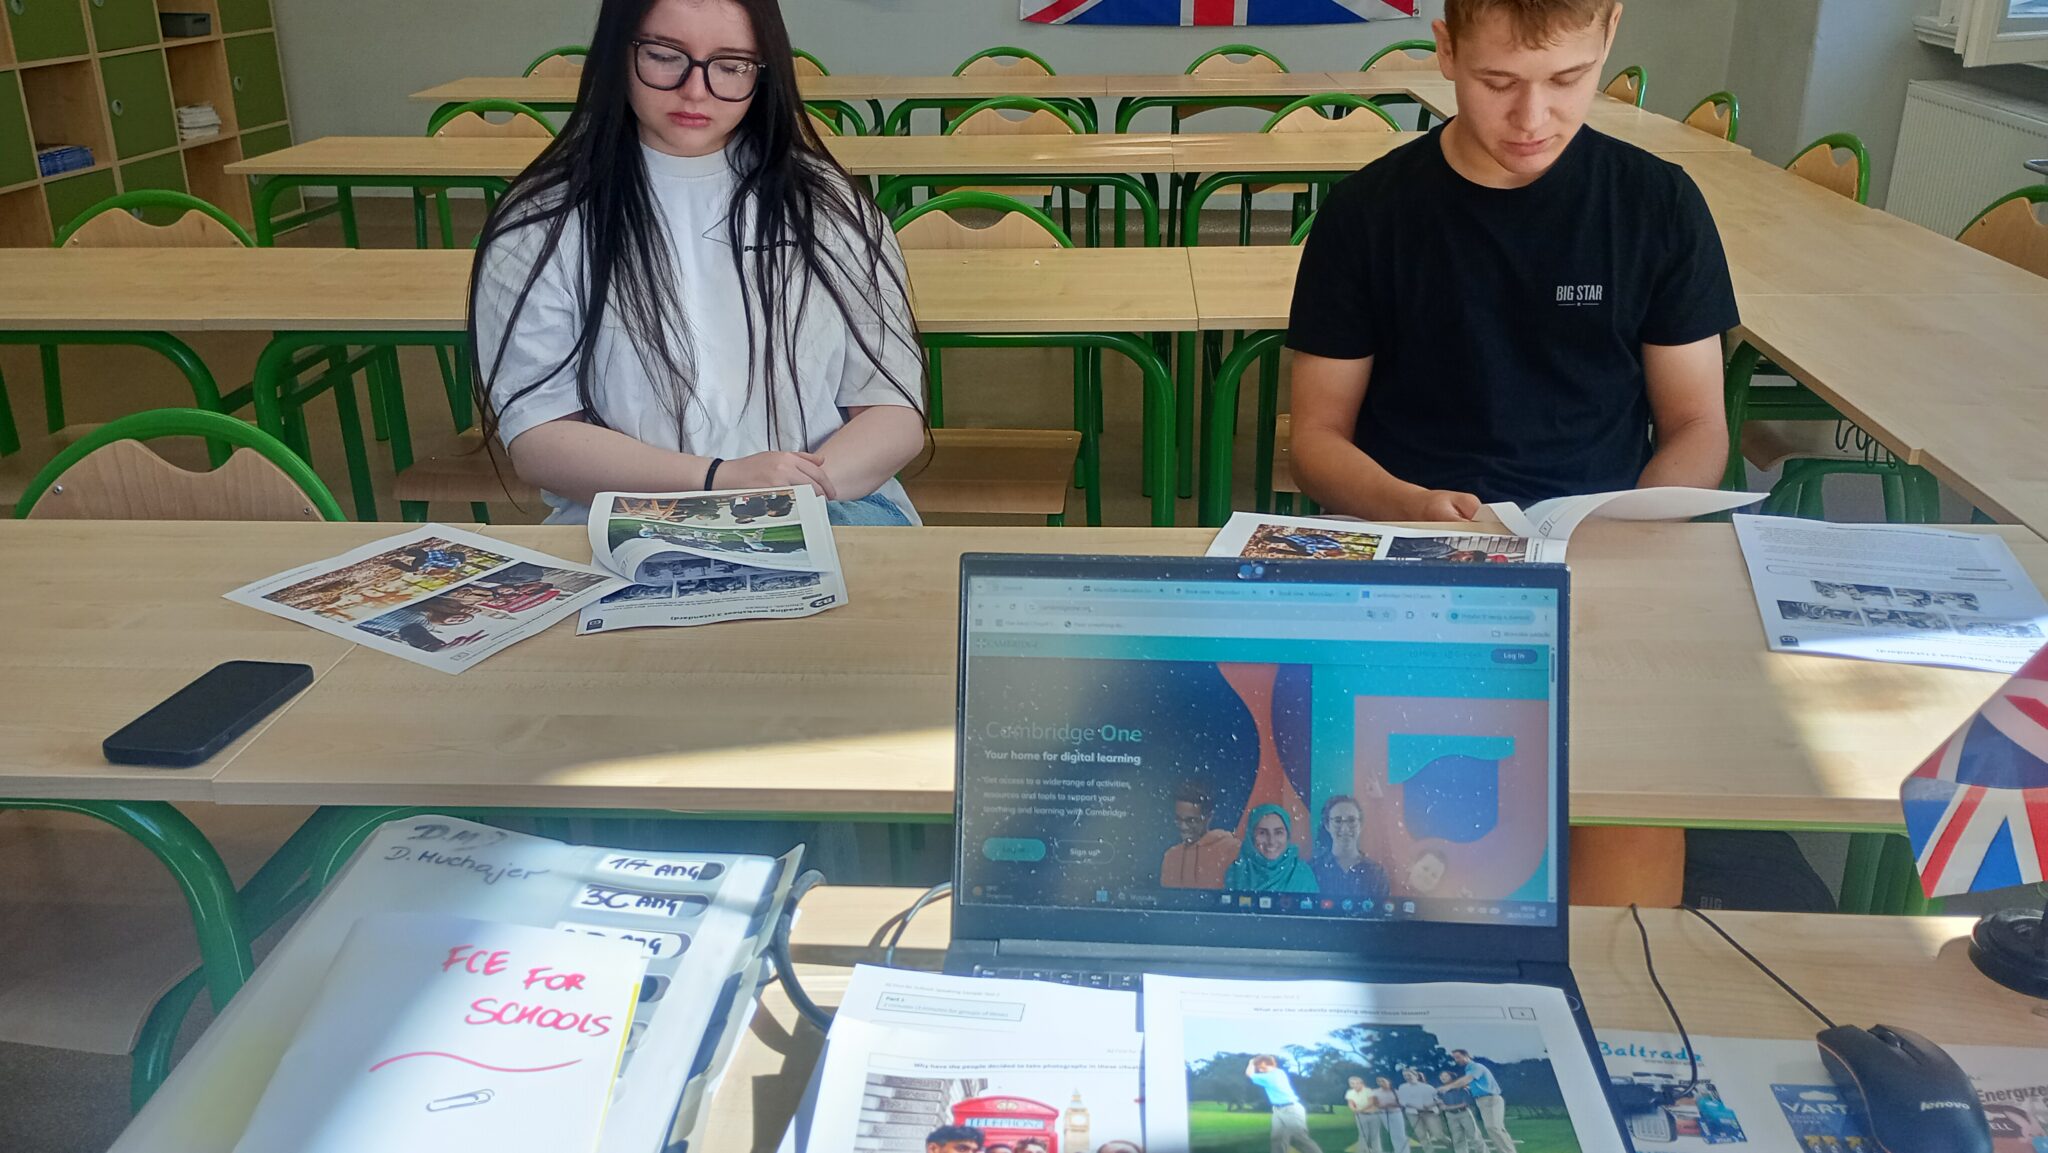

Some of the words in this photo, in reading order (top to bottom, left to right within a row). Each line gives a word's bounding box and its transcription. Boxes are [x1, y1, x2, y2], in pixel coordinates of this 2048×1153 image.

[1556, 285, 1574, 301] BIG
[1576, 285, 1603, 301] STAR
[1503, 652, 1516, 661] Log
[986, 721, 1095, 745] Cambridge
[1101, 724, 1143, 743] One
[984, 750, 1008, 760] Your
[1010, 750, 1040, 761] home
[1042, 751, 1058, 761] for
[1060, 751, 1094, 764] digital
[1097, 752, 1142, 766] learning
[1063, 780, 1086, 788] range
[1021, 792, 1036, 800] and
[1038, 792, 1056, 800] tools
[1068, 794, 1097, 802] support
[1017, 806, 1032, 814] and
[1034, 806, 1064, 816] learning
[1066, 808, 1083, 816] with
[1085, 808, 1127, 818] Cambridge
[1070, 847, 1086, 858] Sign
[443, 944, 511, 976] FCE
[523, 967, 587, 992] FOR
[464, 997, 611, 1037] SCHOOLS
[914, 1062, 928, 1070] Why
[1976, 1085, 2048, 1103] Energize
[1783, 1102, 1849, 1115] VART
[969, 1118, 1042, 1129] TELEPHONE
